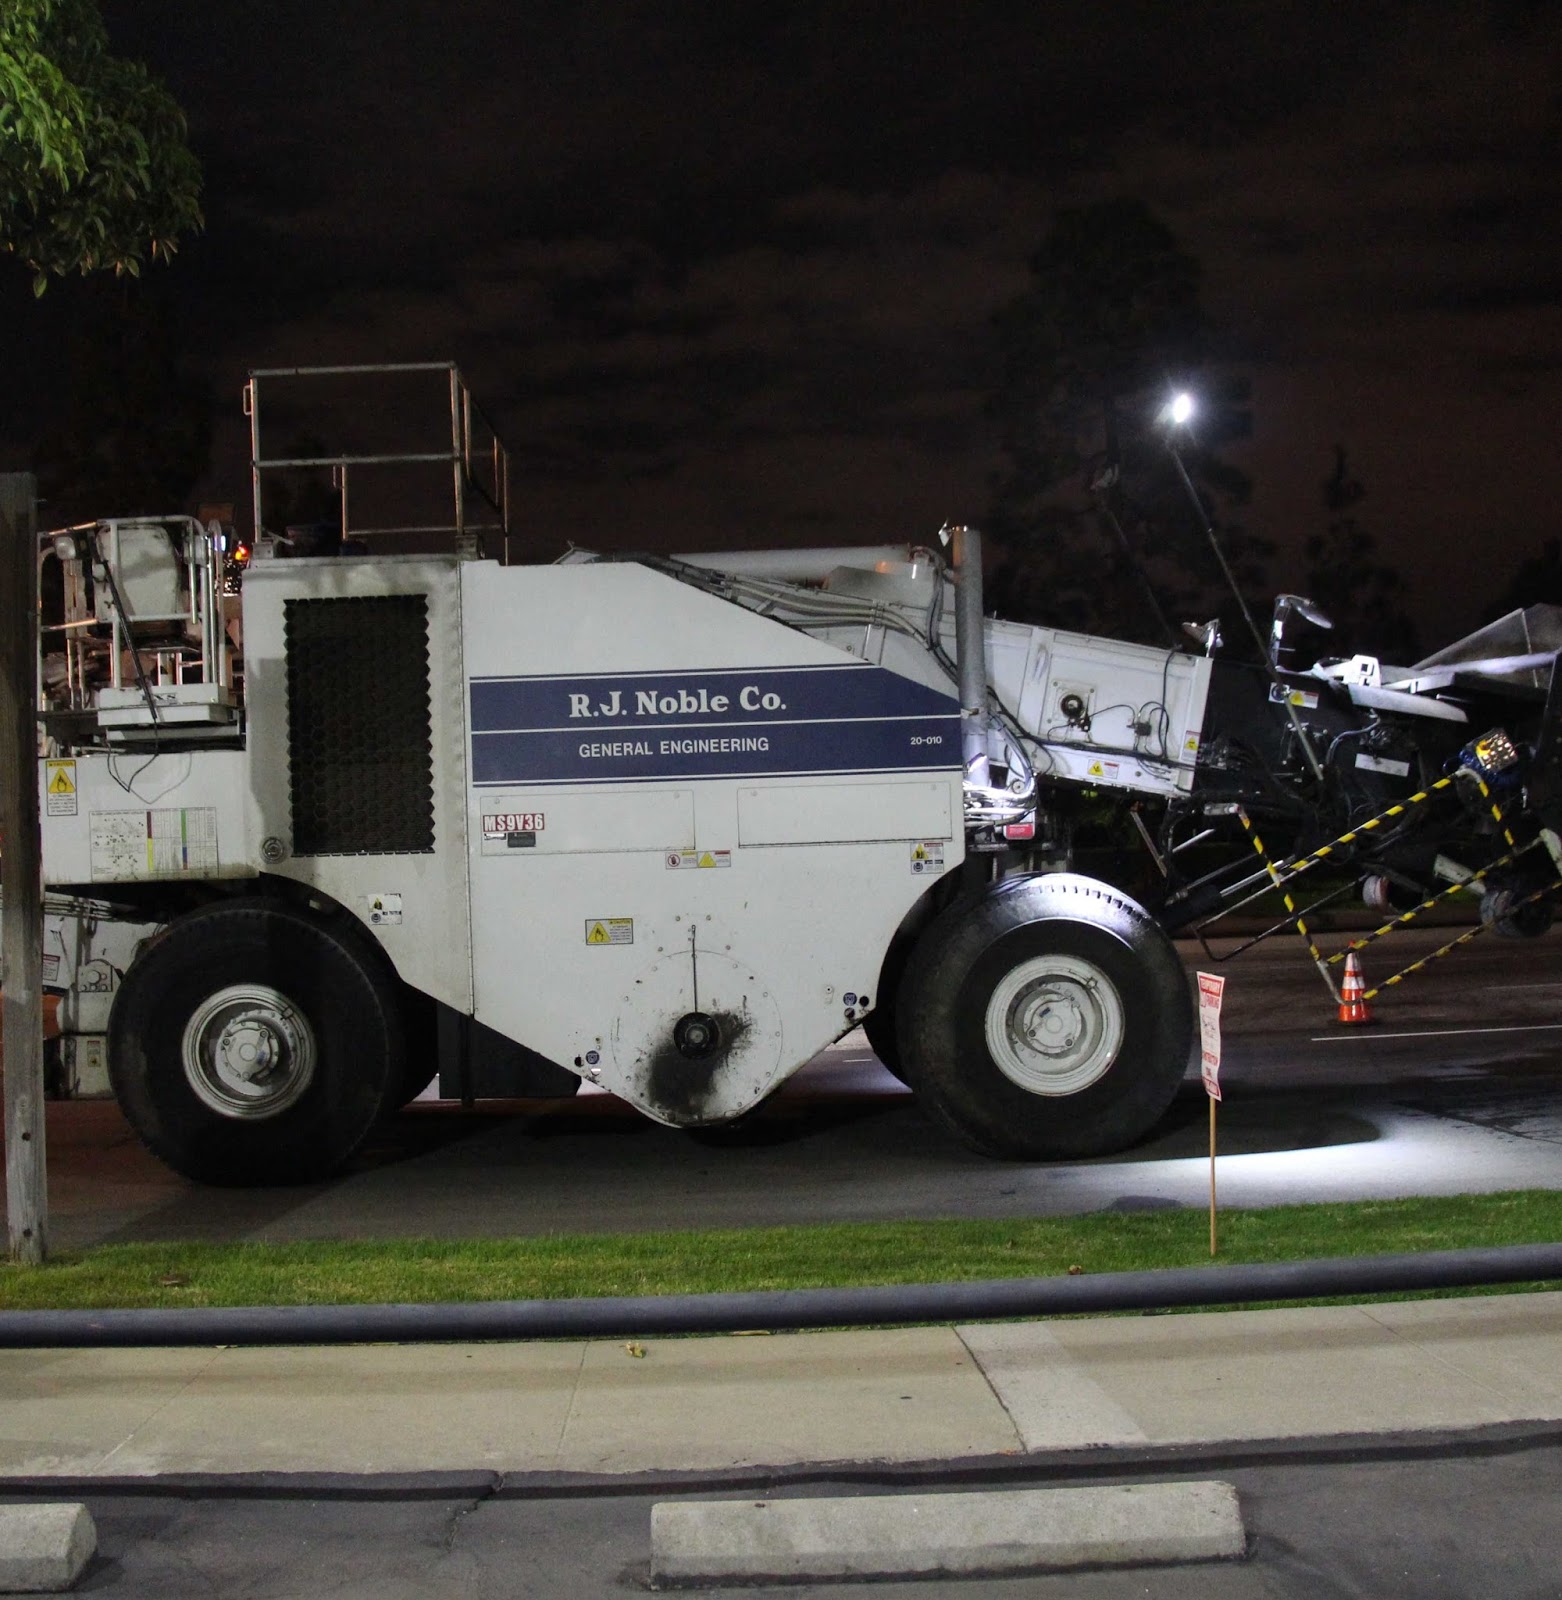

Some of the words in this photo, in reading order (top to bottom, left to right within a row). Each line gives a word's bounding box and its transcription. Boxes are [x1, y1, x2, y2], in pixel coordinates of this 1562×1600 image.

[635, 689, 730, 716] Noble
[739, 686, 787, 711] Co.
[578, 741, 654, 758] GENERAL
[660, 737, 769, 754] ENGINEERING
[910, 735, 943, 745] 20-010
[483, 813, 544, 832] MS9V36
